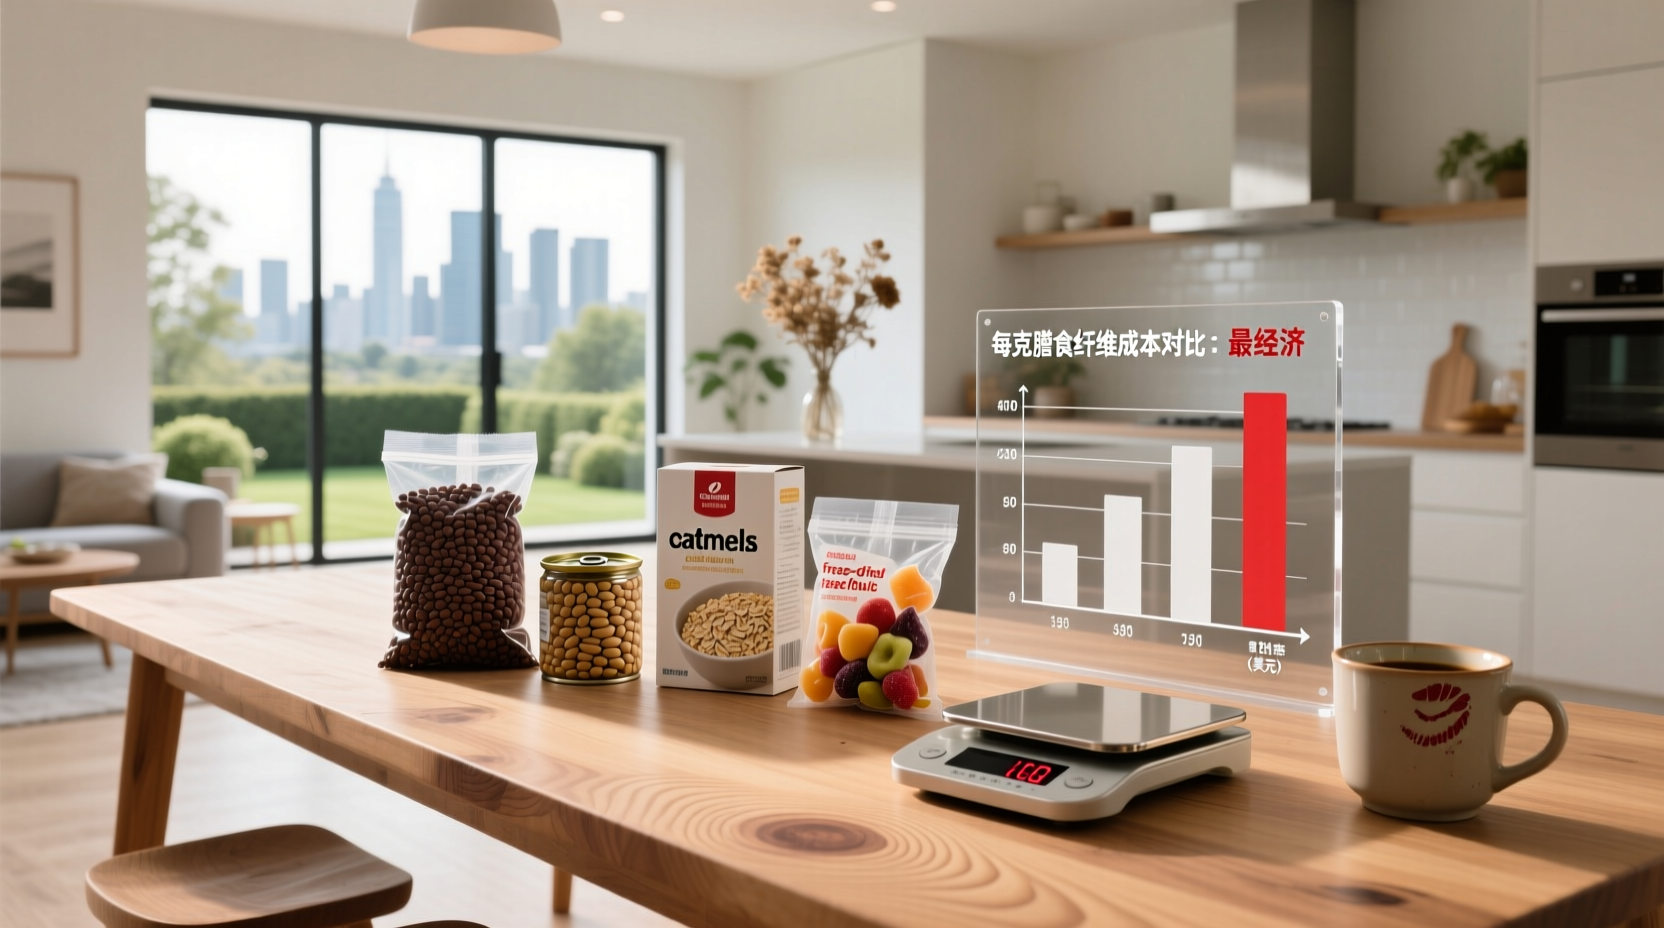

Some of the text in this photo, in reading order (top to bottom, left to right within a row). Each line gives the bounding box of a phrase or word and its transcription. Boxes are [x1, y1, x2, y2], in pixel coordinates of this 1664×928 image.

[1228, 327, 1305, 357] 最经济
[669, 528, 758, 552] catmels
